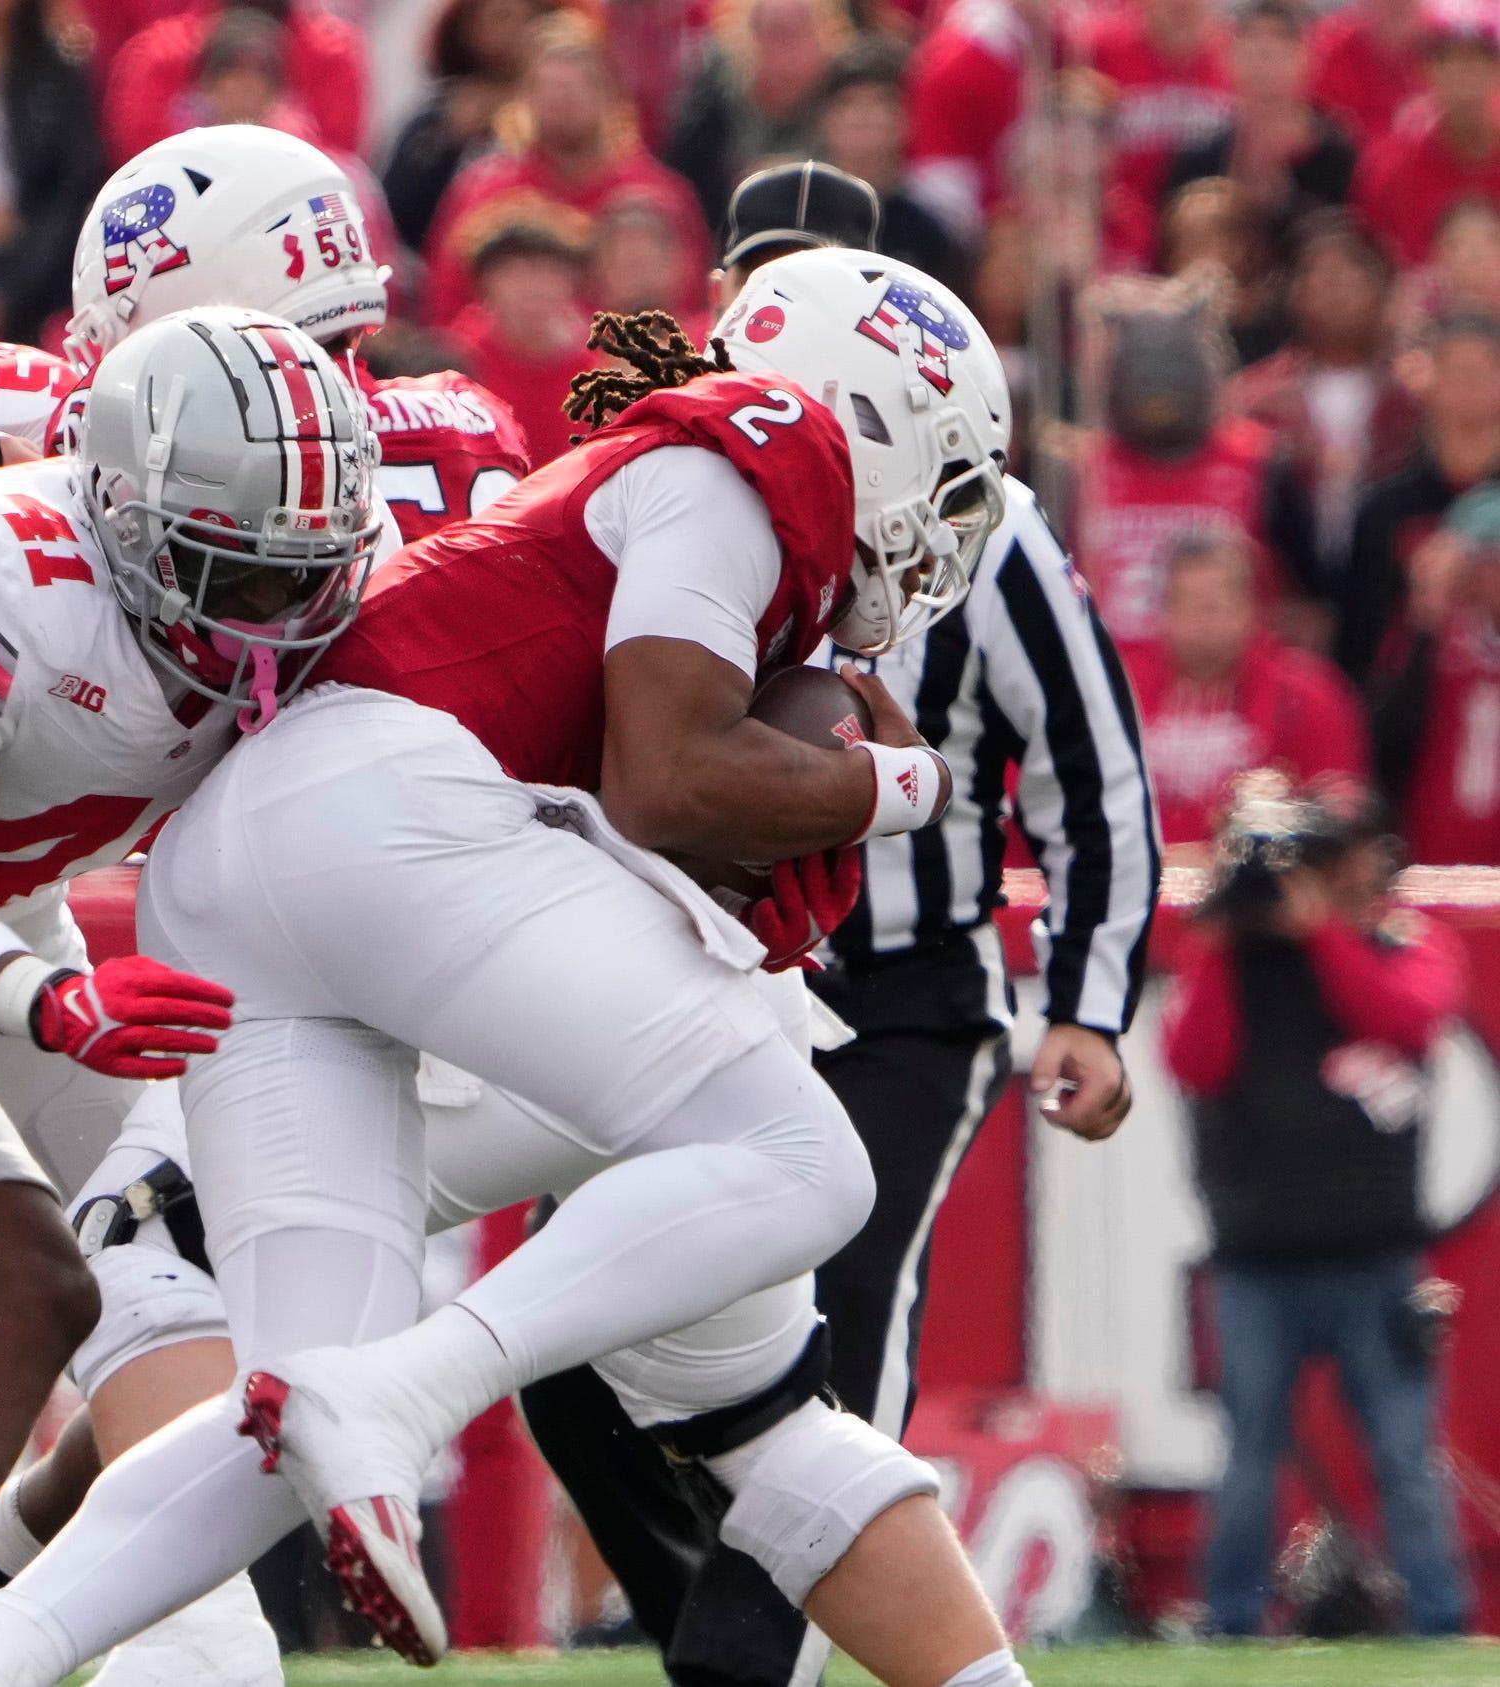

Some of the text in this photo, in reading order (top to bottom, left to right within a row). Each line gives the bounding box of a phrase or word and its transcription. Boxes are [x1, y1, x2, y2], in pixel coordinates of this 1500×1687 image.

[101, 184, 190, 296] R
[315, 223, 362, 268] 59
[855, 276, 970, 398] R
[728, 388, 803, 447] 2
[2, 493, 96, 587] 41
[911, 763, 920, 807] adidas
